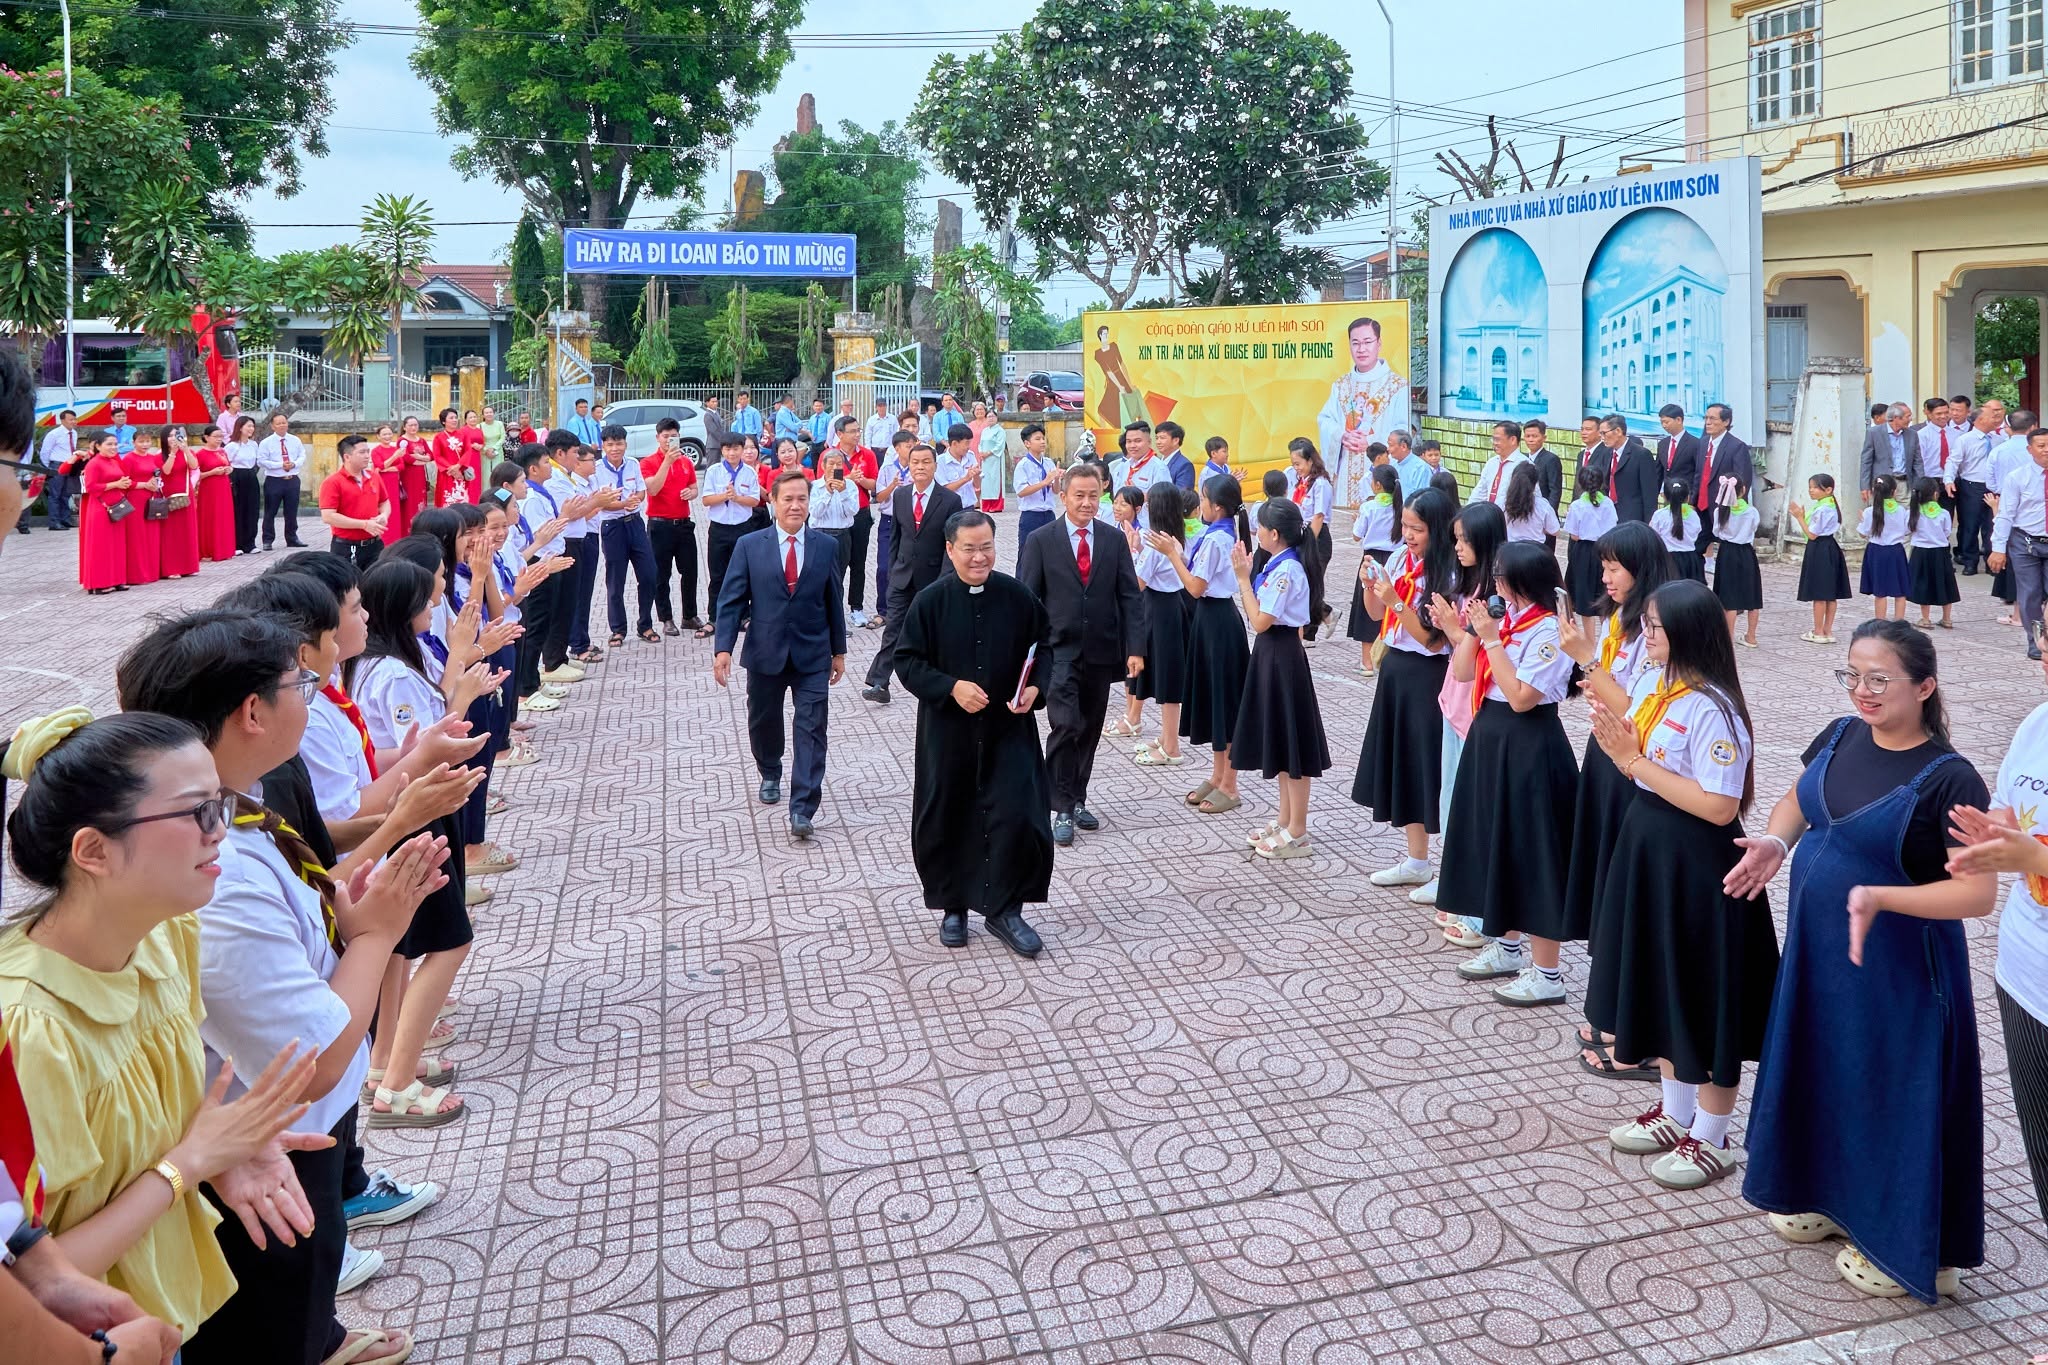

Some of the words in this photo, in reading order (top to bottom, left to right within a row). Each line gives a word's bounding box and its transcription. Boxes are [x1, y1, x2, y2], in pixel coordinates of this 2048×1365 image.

[1449, 208, 1471, 231] NHÀ
[1472, 207, 1494, 229] MỤC
[1495, 205, 1508, 226] VỤ
[1509, 199, 1522, 222] VÀ
[1524, 196, 1546, 220] NHÀ
[1548, 192, 1565, 217] XỨ
[1567, 190, 1597, 214] GIÁO
[1599, 184, 1619, 210] XỨ
[1620, 181, 1652, 207] LIÊN
[1653, 179, 1684, 203] KIM
[1686, 173, 1720, 198] SƠN
[576, 238, 614, 263] HÃY
[618, 242, 643, 263] RA
[647, 242, 666, 264] ĐI
[671, 243, 717, 265] LOAN
[722, 240, 760, 265] BÁO
[763, 244, 790, 266] TIN
[795, 241, 846, 266] MỪNG
[1146, 322, 1174, 337] CỘNG
[1176, 321, 1205, 335] ĐOÀN
[1208, 320, 1232, 336] GIÁO
[1252, 319, 1275, 333] LIÊN
[1279, 319, 1298, 333] KIM
[1301, 318, 1324, 332] SƠN
[1138, 345, 1152, 360] XIN
[1156, 345, 1169, 360] TRI
[1187, 344, 1205, 360] CHA
[1208, 341, 1221, 360] XỨ
[1224, 343, 1249, 360] GIUSE
[1253, 341, 1268, 360] BÙI
[1271, 339, 1297, 359] TUẤN
[1301, 342, 1333, 359] PHONG
